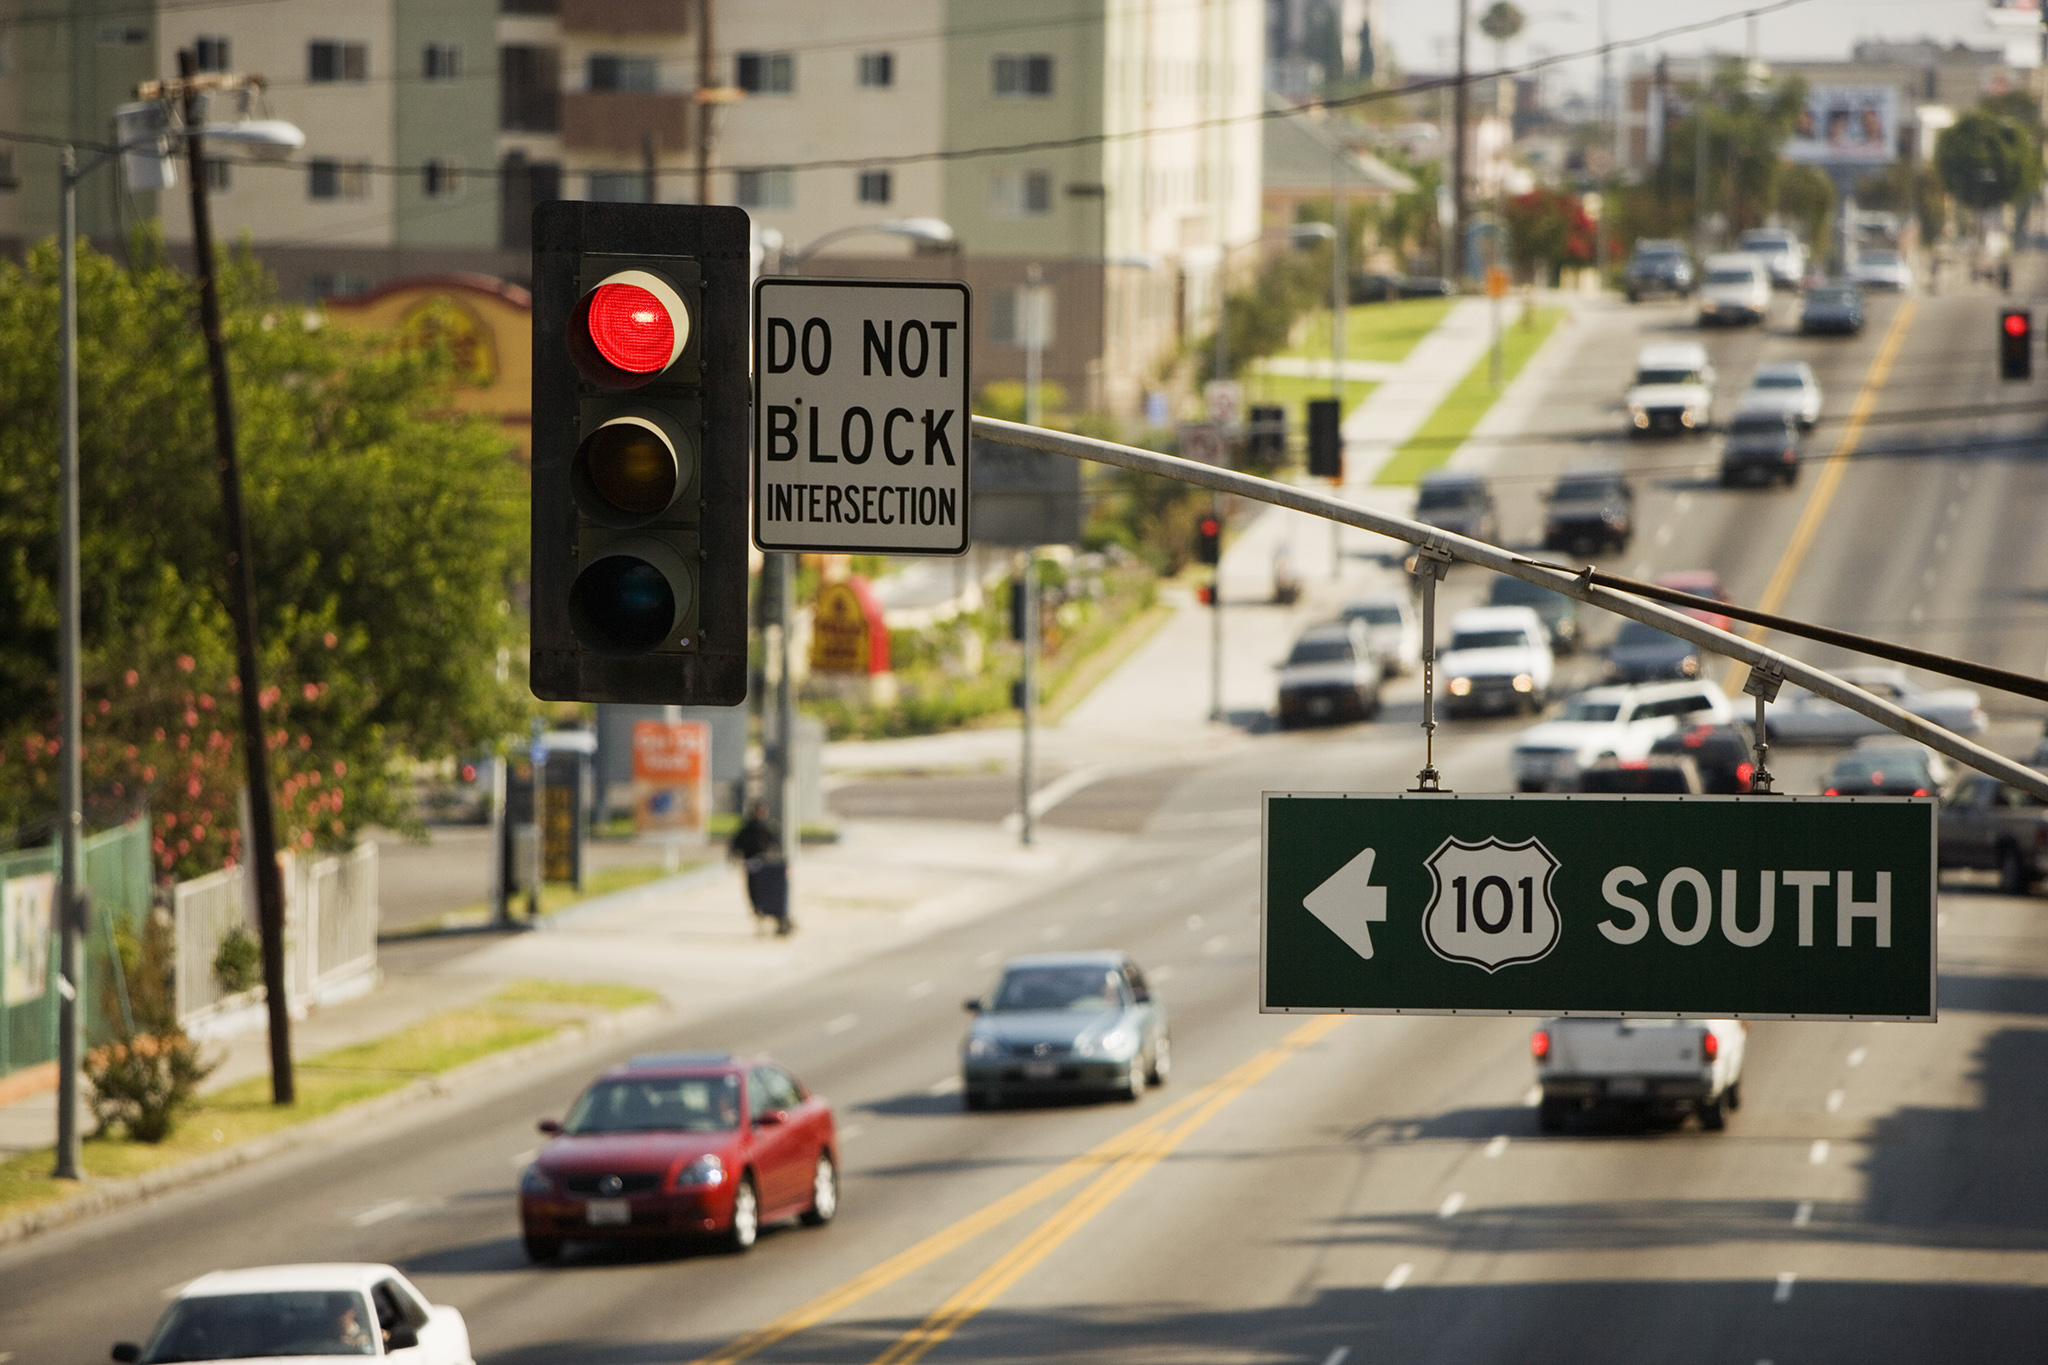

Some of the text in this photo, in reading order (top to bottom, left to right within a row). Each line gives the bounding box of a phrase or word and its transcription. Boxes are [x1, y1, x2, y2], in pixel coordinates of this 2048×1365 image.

[767, 317, 957, 378] DO NOT
[767, 405, 956, 466] BLOCK
[767, 483, 956, 526] INTERSECTION
[1451, 865, 1892, 948] 101 SOUTH
